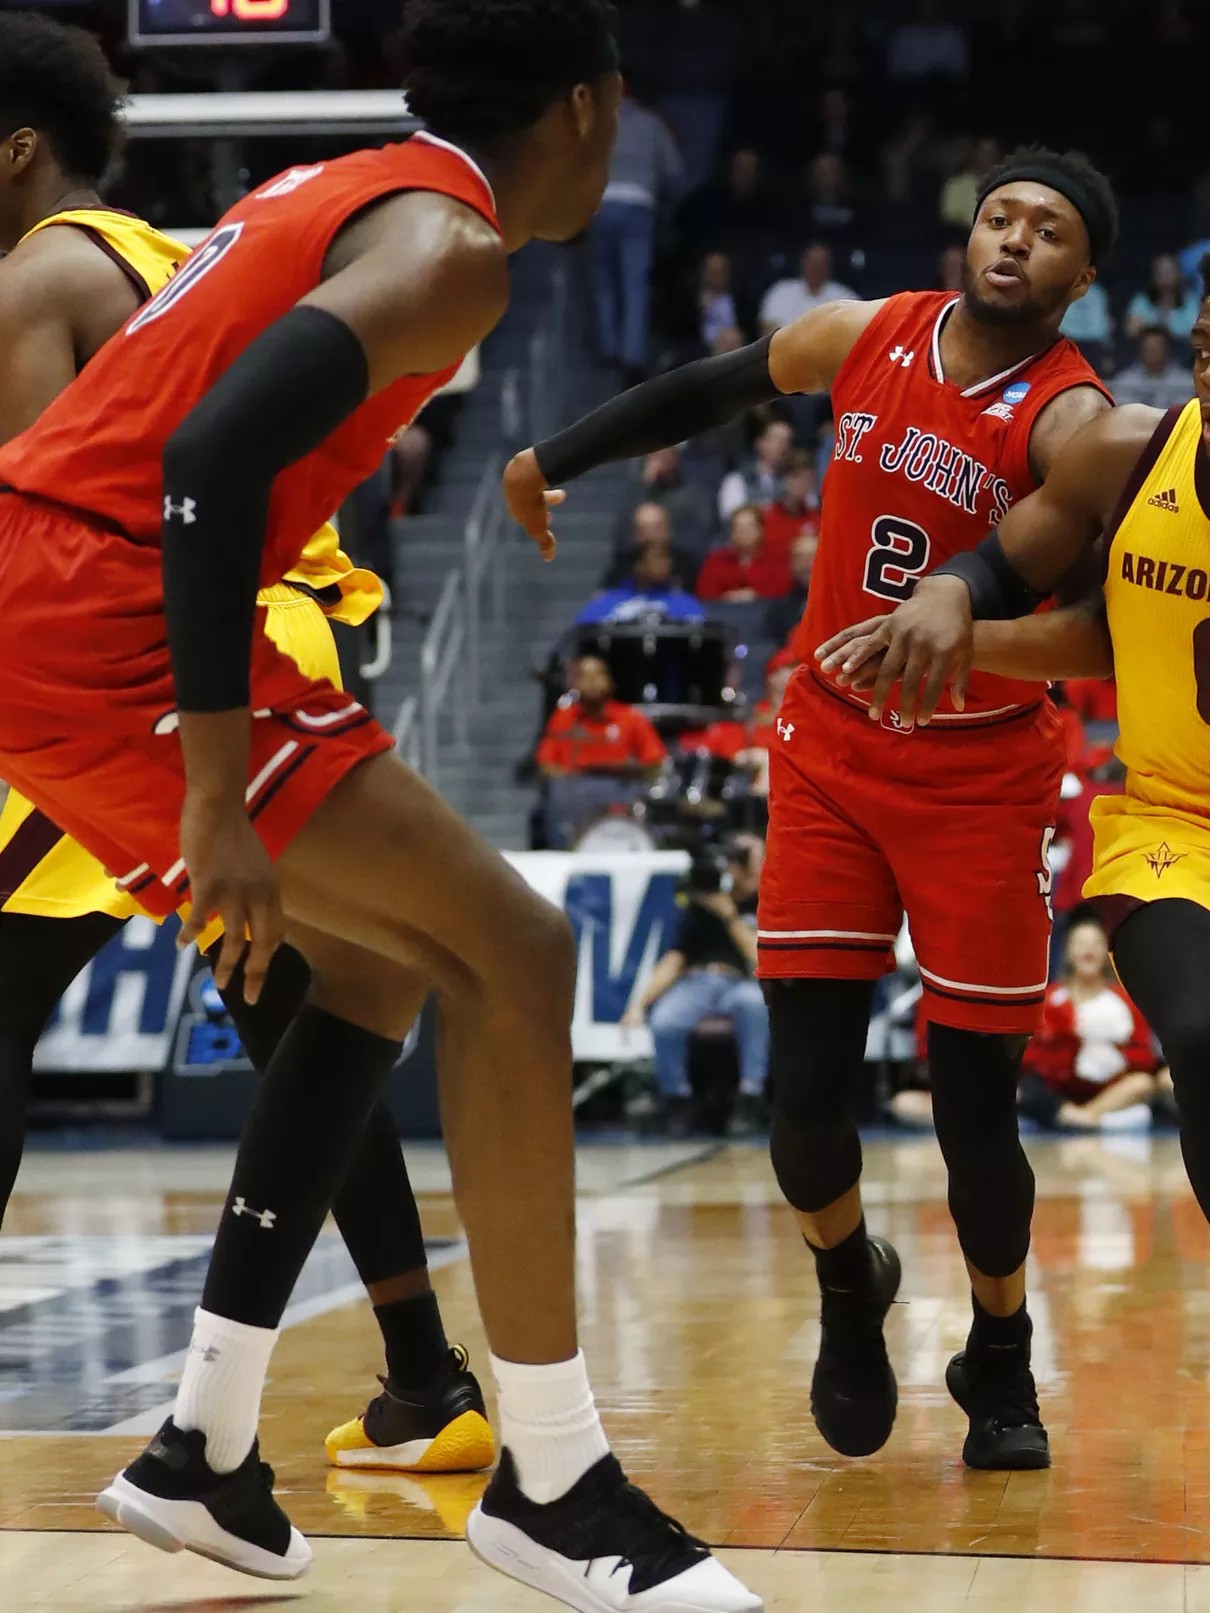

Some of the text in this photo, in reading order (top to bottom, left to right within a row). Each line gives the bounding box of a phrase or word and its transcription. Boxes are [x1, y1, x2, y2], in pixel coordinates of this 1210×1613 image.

[834, 412, 1013, 526] ST. JOHN'S
[1148, 496, 1179, 513] adidas
[862, 514, 930, 603] 2
